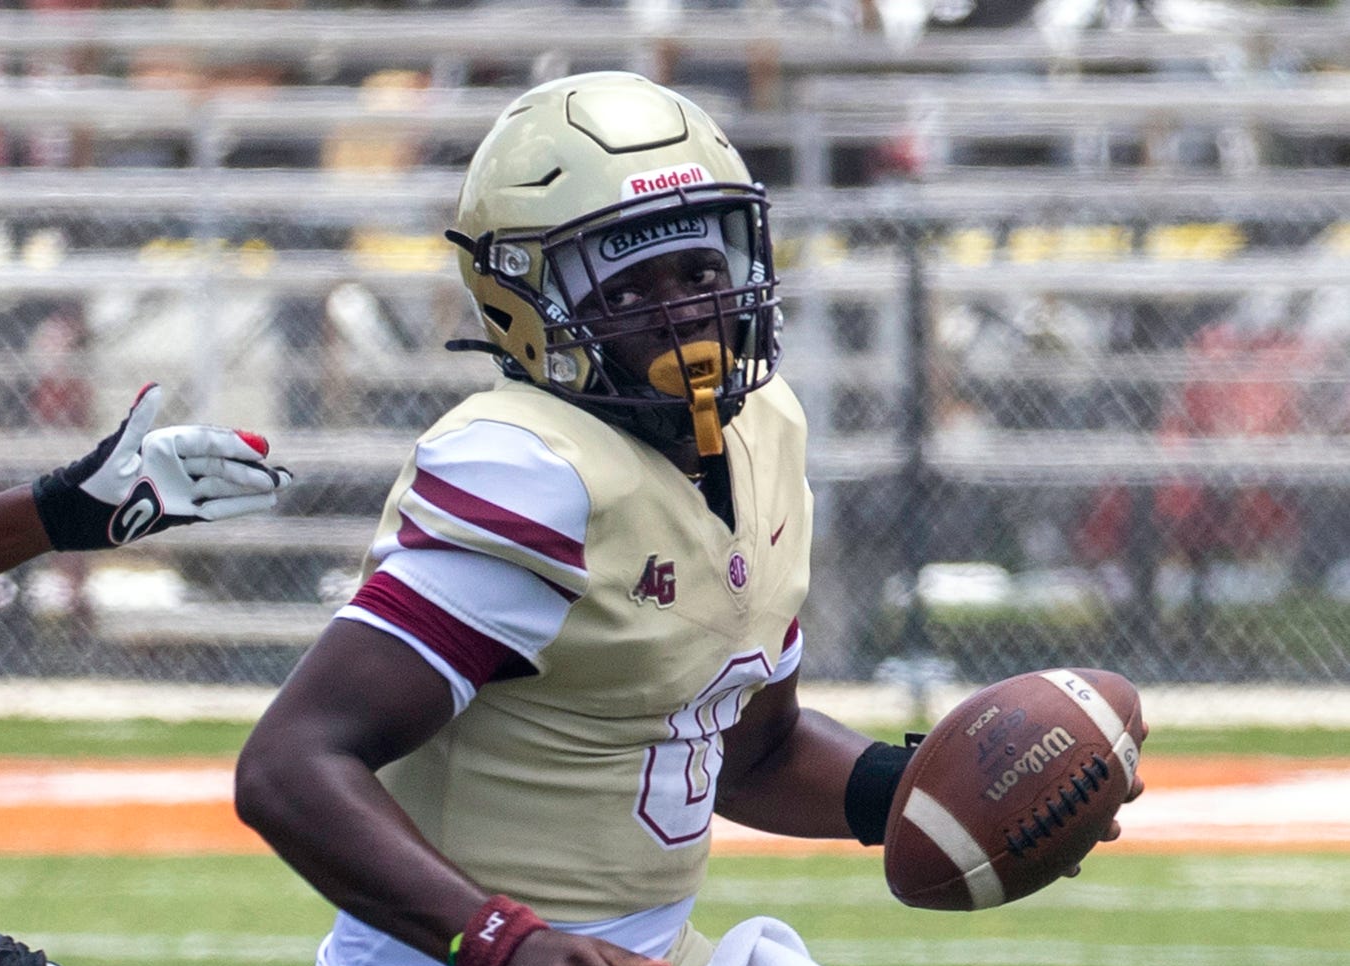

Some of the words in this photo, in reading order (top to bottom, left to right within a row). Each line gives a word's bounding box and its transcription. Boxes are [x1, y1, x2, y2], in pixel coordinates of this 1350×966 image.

[631, 167, 704, 195] Riddell
[609, 217, 702, 255] BATTLE
[1065, 679, 1091, 703] LG
[966, 705, 1002, 738] NCAA
[633, 648, 773, 850] 0
[986, 726, 1077, 801] Wilson
